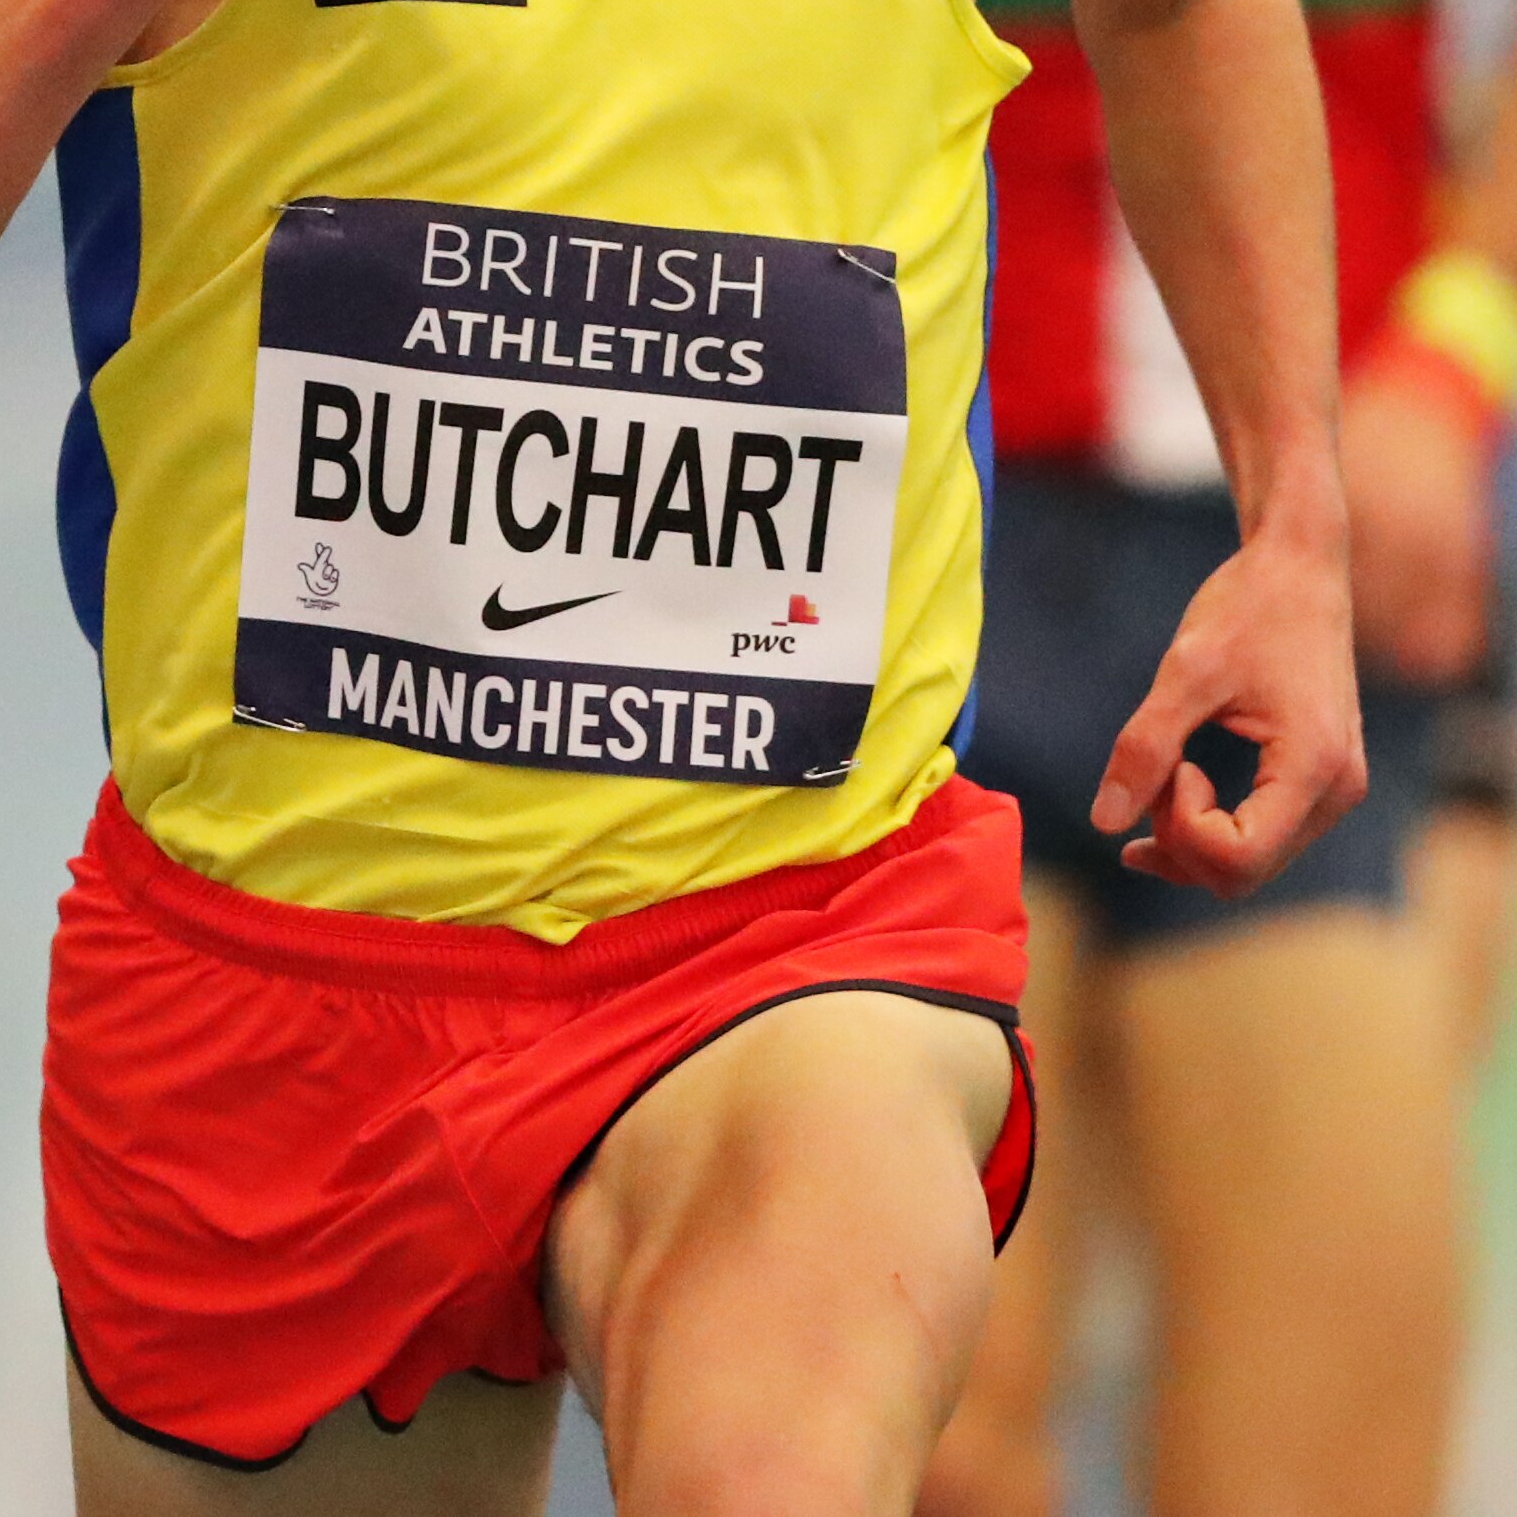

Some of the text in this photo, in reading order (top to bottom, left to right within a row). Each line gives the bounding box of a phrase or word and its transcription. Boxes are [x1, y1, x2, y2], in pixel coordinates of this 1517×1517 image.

[421, 222, 764, 318] BRITISH
[403, 307, 765, 386] ATHLETICS
[294, 380, 863, 573] BUTCHART
[731, 632, 796, 657] pwc
[327, 647, 775, 771] MANCHESTER
